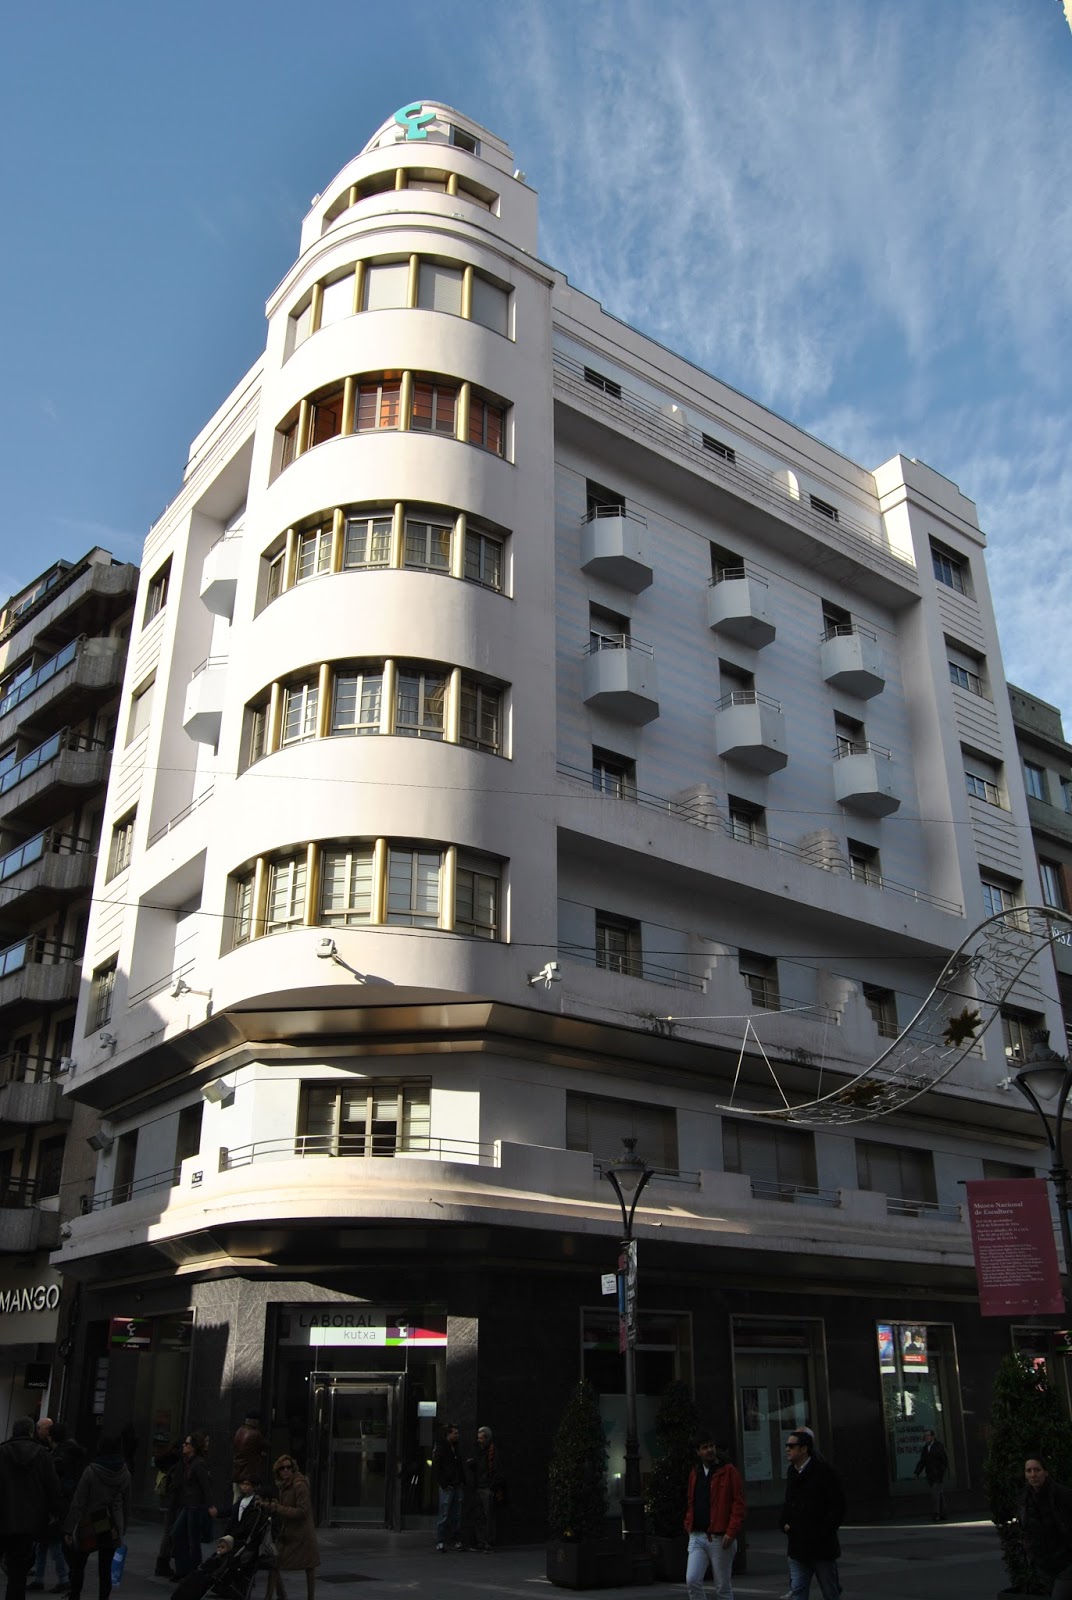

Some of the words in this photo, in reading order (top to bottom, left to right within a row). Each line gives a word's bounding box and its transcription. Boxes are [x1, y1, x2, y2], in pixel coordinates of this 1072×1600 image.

[0, 1284, 60, 1313] MANGO
[299, 1314, 376, 1328] LABORAL
[343, 1330, 376, 1340] kutxa
